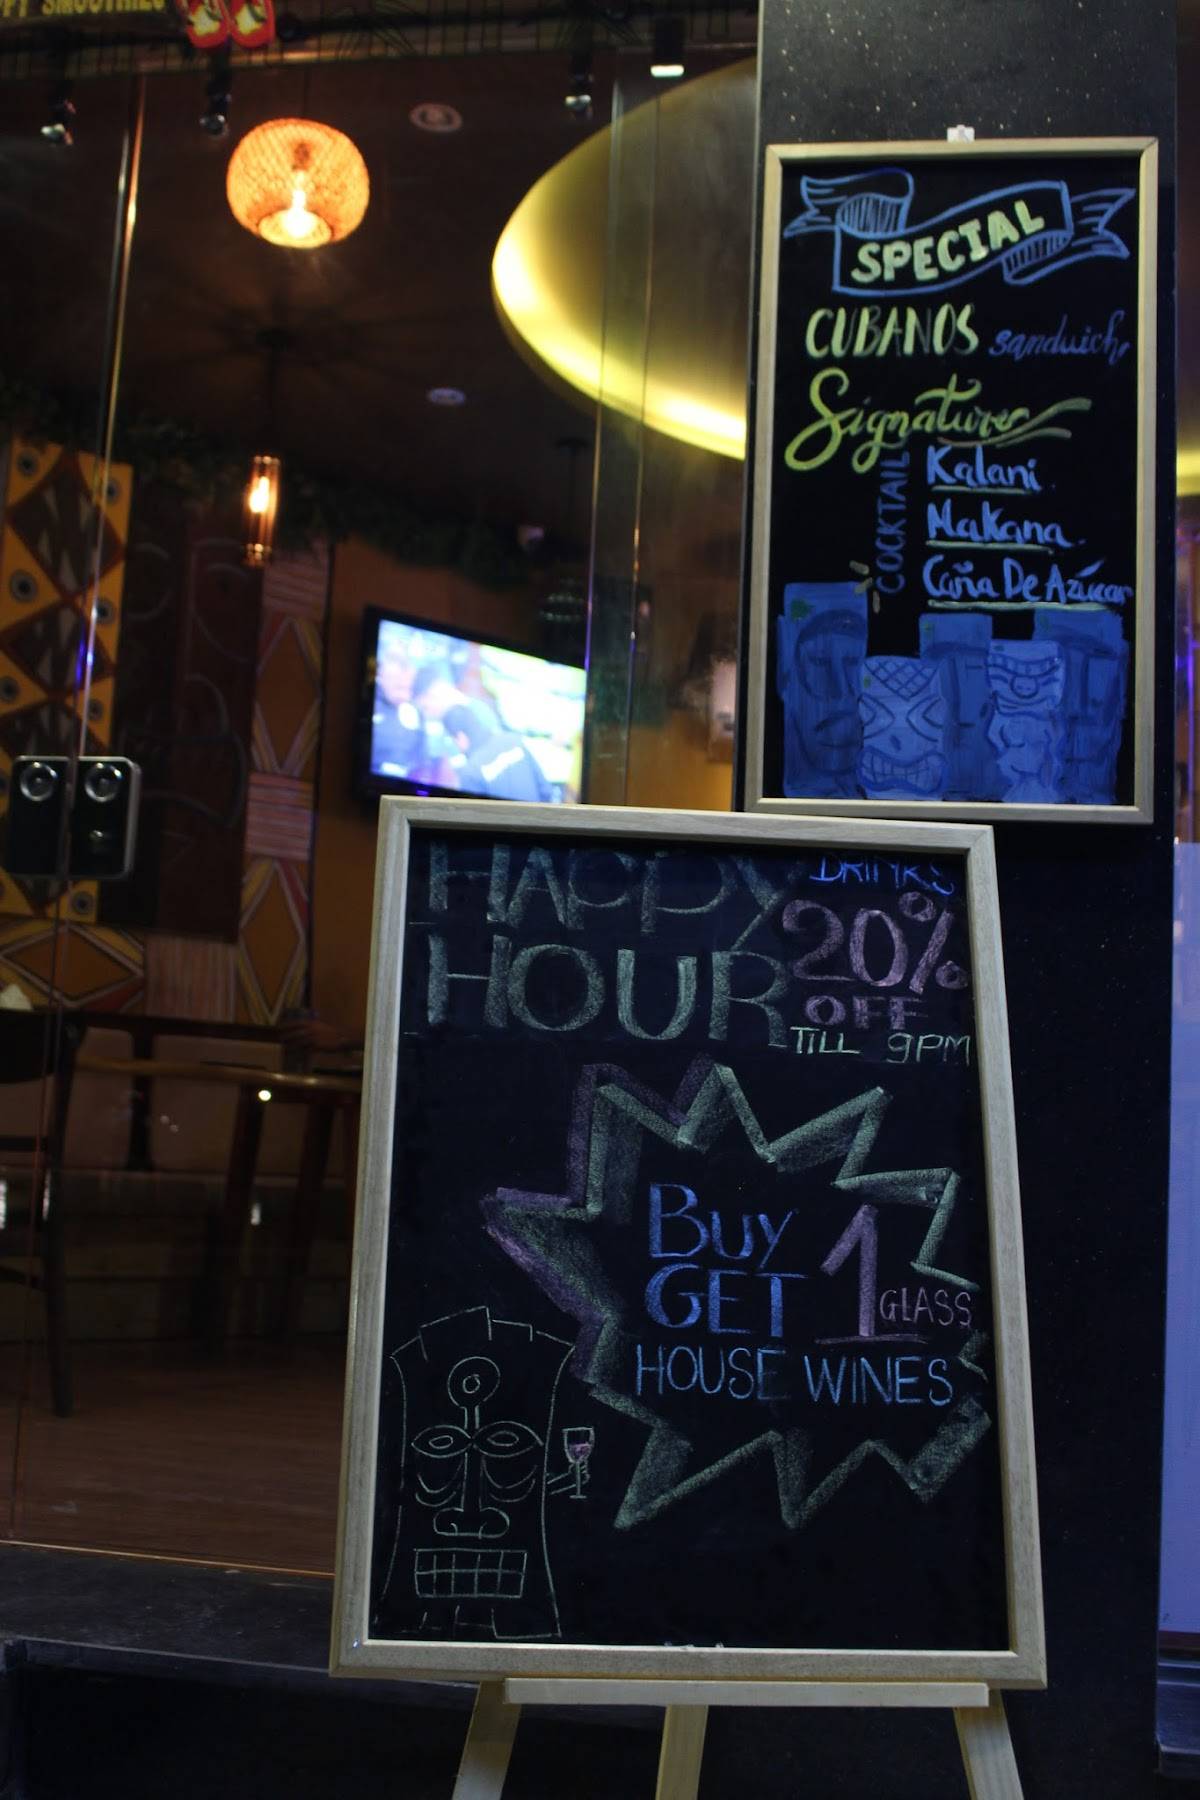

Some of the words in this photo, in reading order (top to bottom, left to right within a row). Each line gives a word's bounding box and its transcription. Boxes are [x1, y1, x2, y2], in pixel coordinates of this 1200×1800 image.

[850, 200, 1046, 284] SPECIAL
[805, 303, 980, 358] CUBANOS
[784, 366, 1070, 474] Signature
[926, 445, 1043, 493] Kalani
[874, 450, 911, 594] COCKTAIL
[922, 553, 1000, 600] Caña
[1003, 556, 1041, 601] De
[428, 840, 786, 951] HAPPY
[782, 891, 969, 995] 20%
[427, 935, 789, 1048] HOUR
[805, 995, 929, 1030] OFF
[790, 1026, 862, 1055] TILL
[886, 1032, 972, 1066] 9PM
[644, 1262, 809, 1338] GET
[817, 1202, 908, 1343] 1
[879, 1288, 973, 1328] GLASS
[636, 1342, 792, 1400] HOUSE
[803, 1354, 955, 1407] WINES
